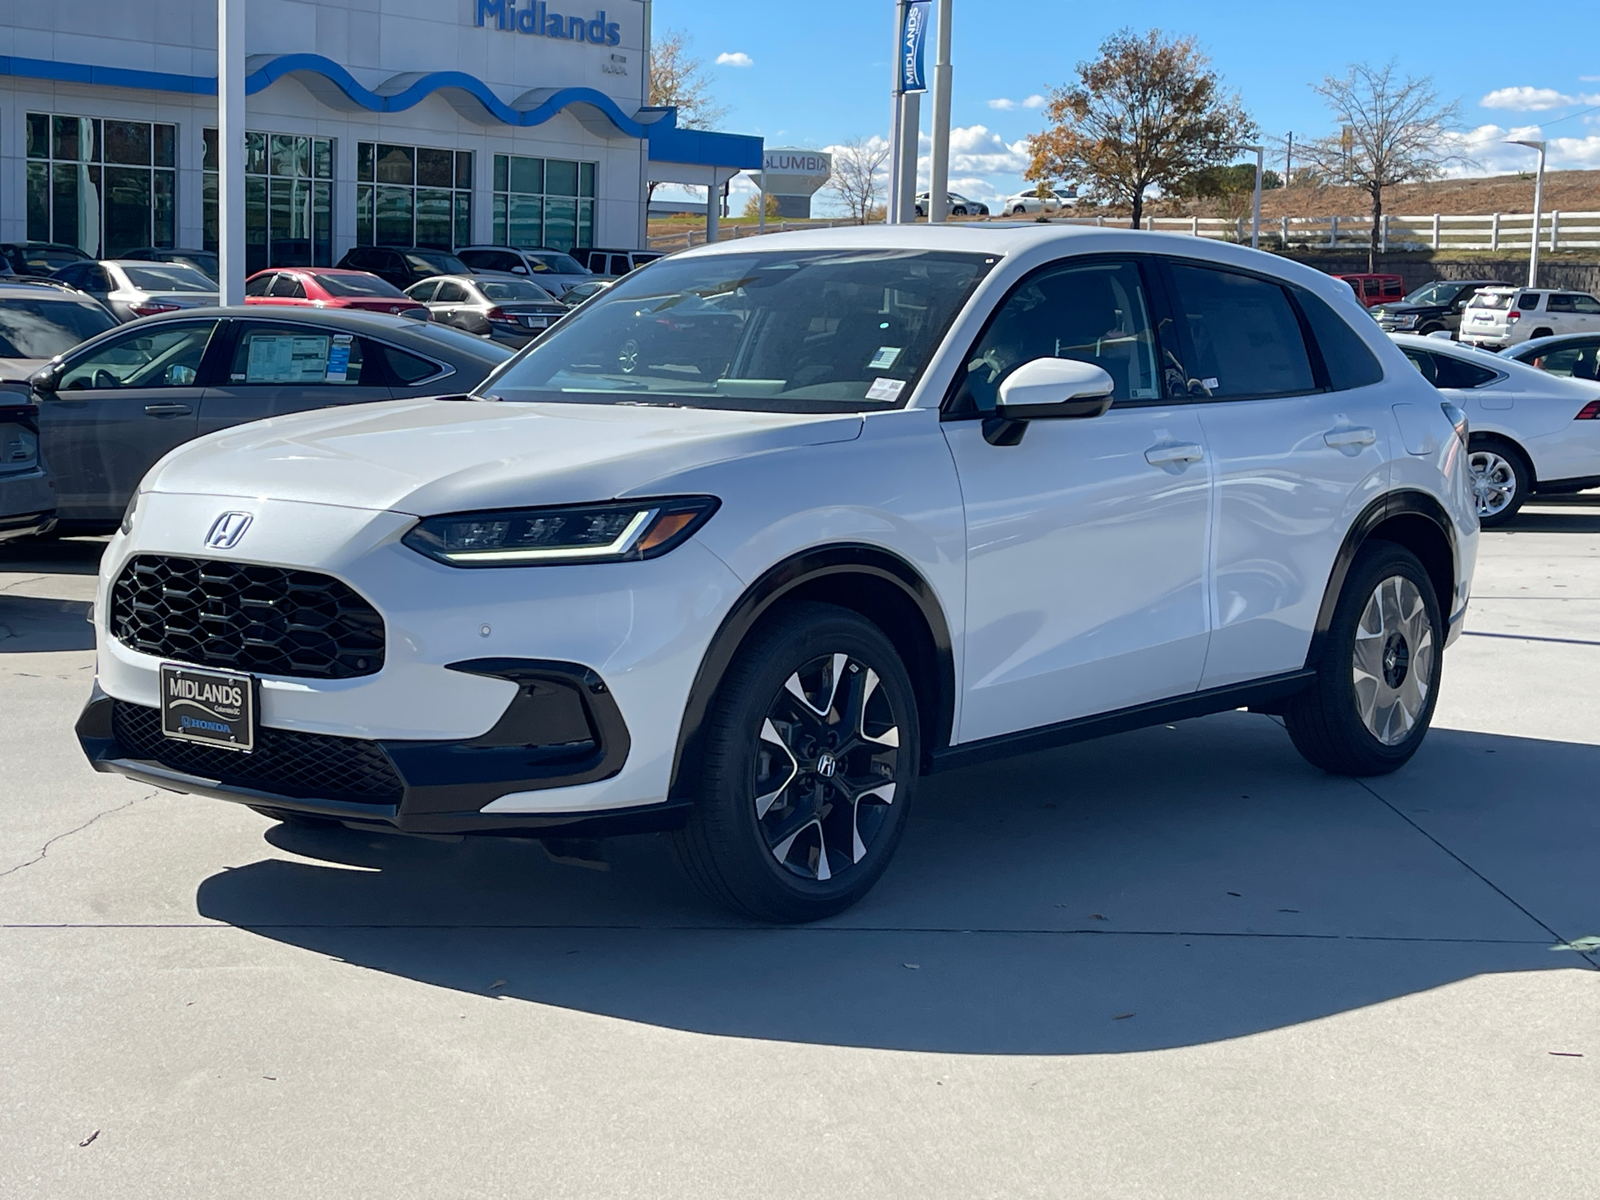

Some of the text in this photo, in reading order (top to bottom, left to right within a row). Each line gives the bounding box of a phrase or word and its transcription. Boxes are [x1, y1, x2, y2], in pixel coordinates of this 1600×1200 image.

[475, 0, 620, 46] Midlands
[906, 7, 918, 84] MIDLANDS
[169, 677, 242, 706] MIDLANDS
[191, 719, 232, 733] HONDA
